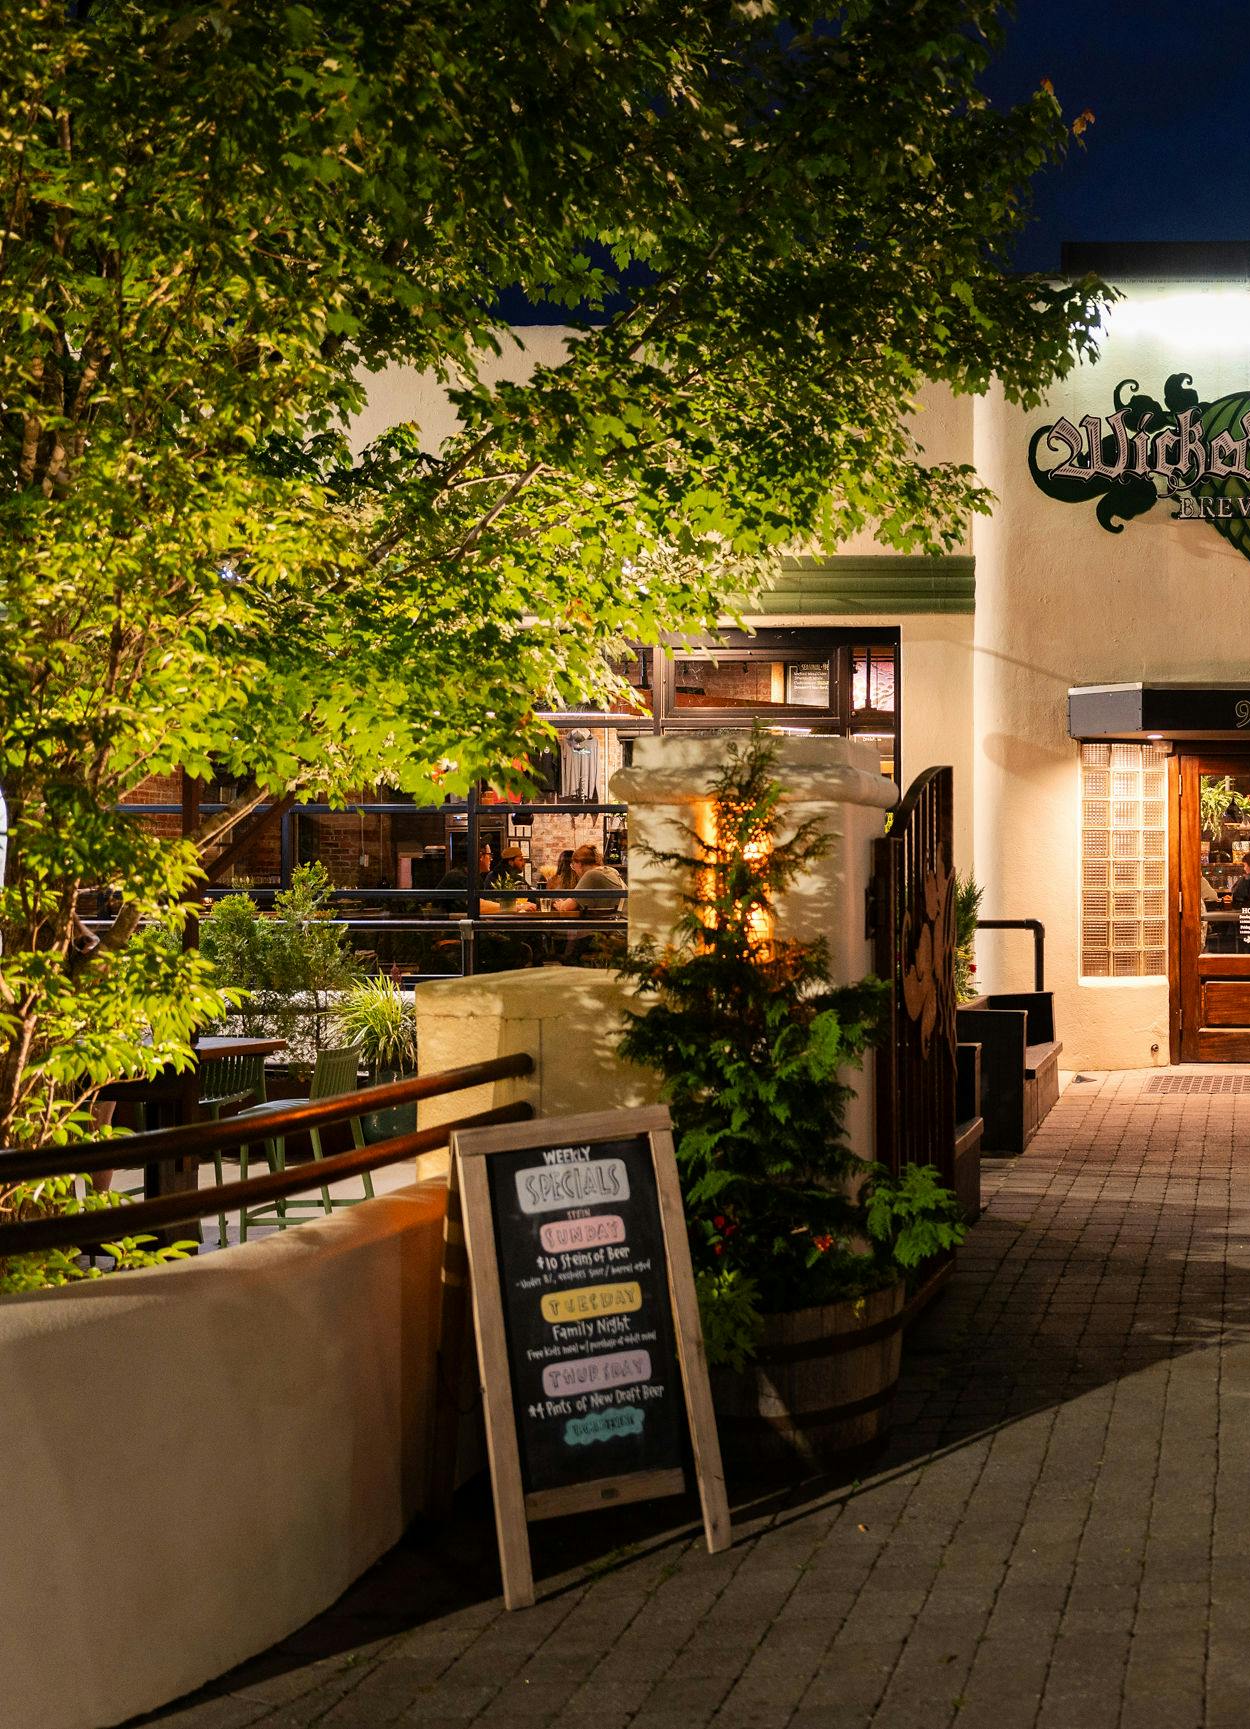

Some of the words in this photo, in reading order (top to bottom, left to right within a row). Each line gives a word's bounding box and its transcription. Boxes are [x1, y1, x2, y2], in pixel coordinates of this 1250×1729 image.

[543, 1146, 591, 1165] WEEKLY
[525, 1163, 621, 1206] SPECIALS
[545, 1221, 620, 1248] SUNDAY
[560, 1252, 593, 1270] Steins
[593, 1249, 605, 1262] of
[606, 1246, 630, 1260] Beer
[549, 1288, 636, 1316] TUESDAY
[551, 1321, 594, 1341] Family
[596, 1315, 631, 1334] Night
[545, 1401, 572, 1416] Pints
[575, 1397, 588, 1413] of
[614, 1387, 640, 1405] Draft
[641, 1384, 664, 1400] Beer
